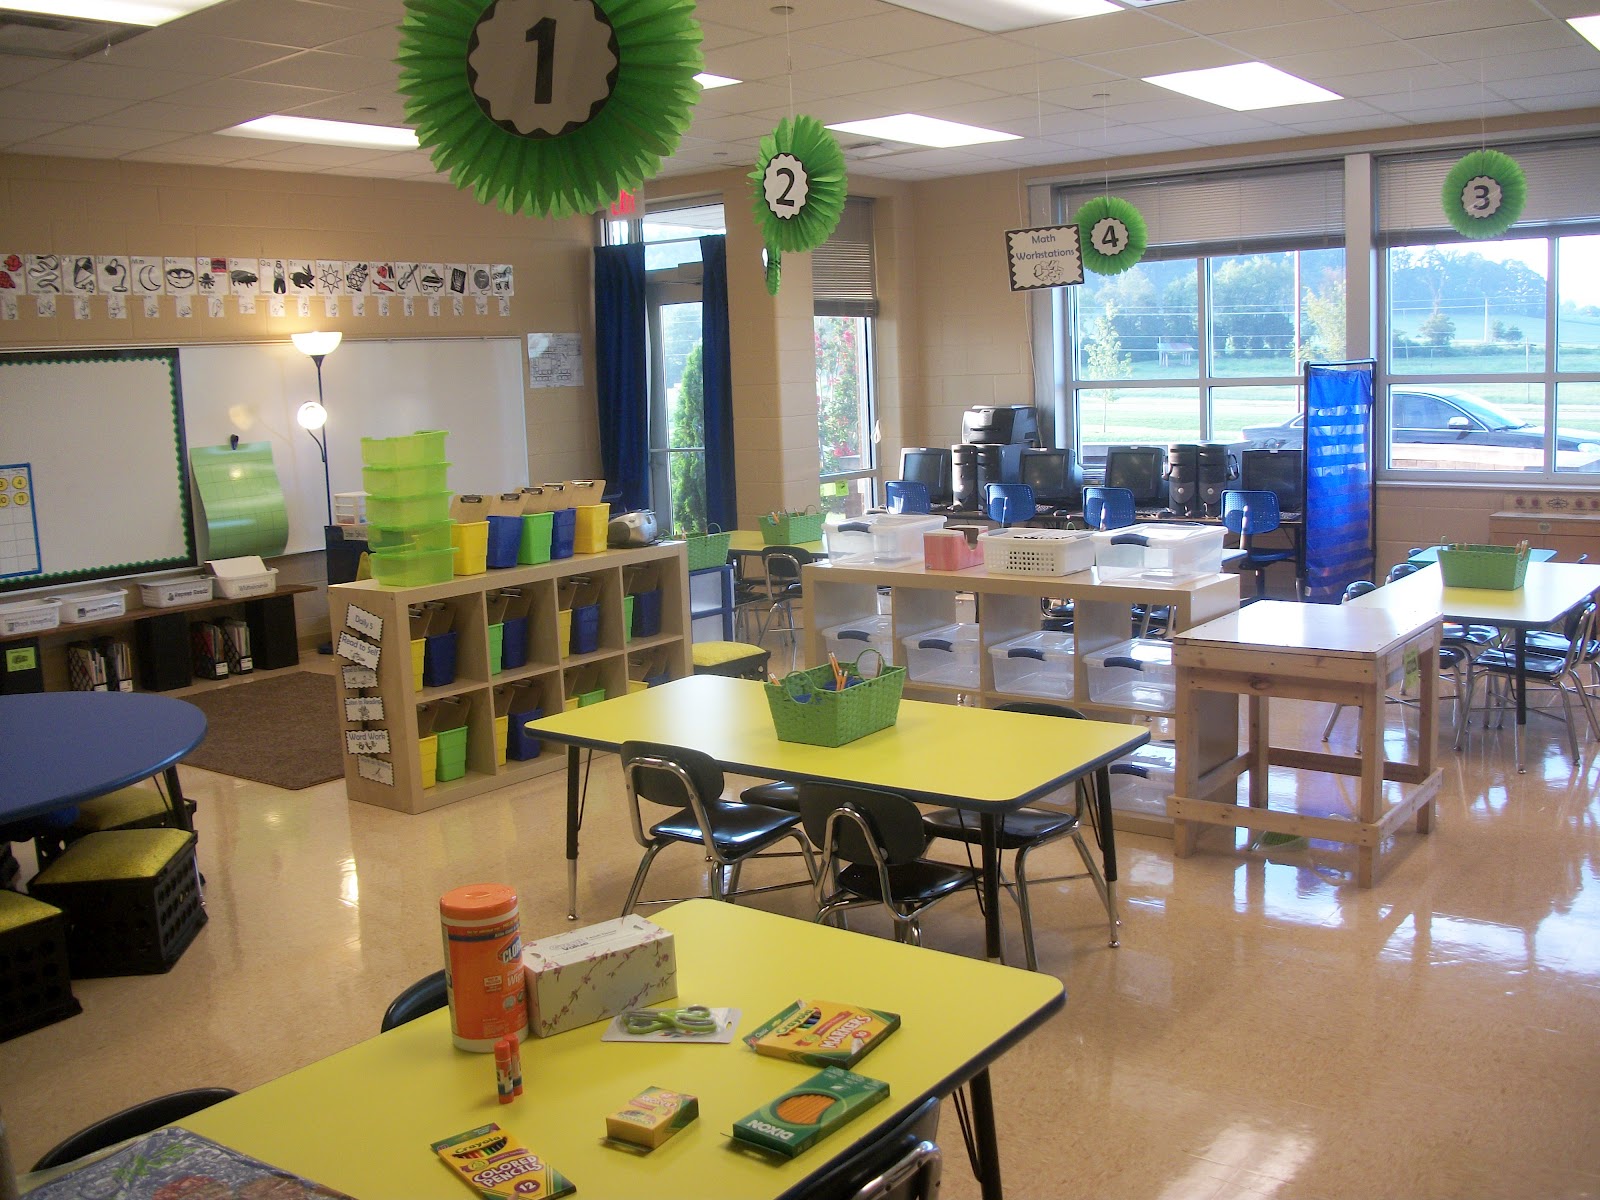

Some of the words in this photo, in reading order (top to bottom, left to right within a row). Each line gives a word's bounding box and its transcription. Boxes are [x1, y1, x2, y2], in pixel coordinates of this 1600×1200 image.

[525, 16, 557, 105] 1
[775, 167, 795, 207] 2
[1473, 184, 1490, 211] 3
[1031, 233, 1056, 245] Math
[1101, 224, 1119, 248] 4
[1015, 248, 1075, 261] Workstations
[355, 614, 370, 630] Daily
[341, 634, 359, 648] Read
[367, 645, 379, 657] Self
[348, 732, 367, 741] Word
[367, 732, 386, 741] Work
[820, 1014, 873, 1049] MARKERS
[746, 1119, 796, 1140] DIXON
[455, 1135, 502, 1154] Crayola
[473, 1155, 538, 1182] COLORED
[482, 1162, 545, 1187] PENCILS
[518, 1181, 537, 1192] 12
